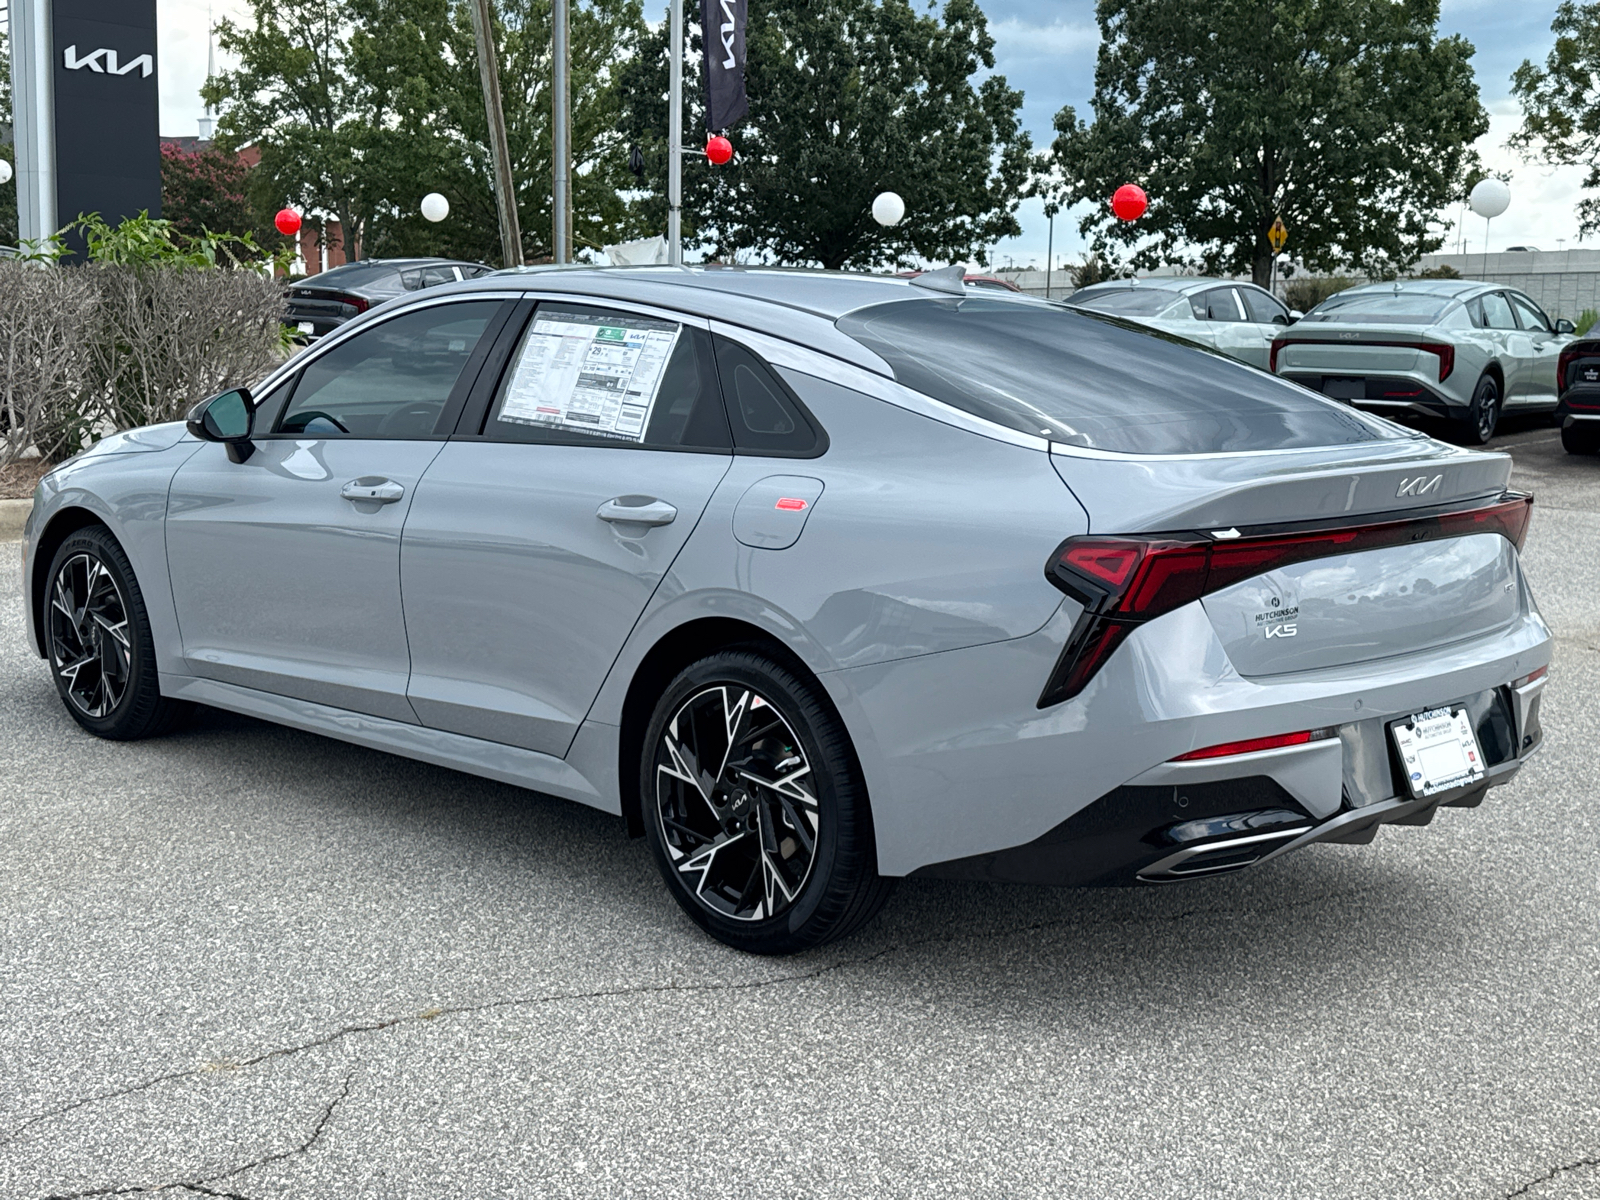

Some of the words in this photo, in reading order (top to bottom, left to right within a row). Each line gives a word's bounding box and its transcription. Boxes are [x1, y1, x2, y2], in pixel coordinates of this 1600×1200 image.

[63, 44, 153, 78] KIA
[591, 346, 602, 356] 29
[1395, 474, 1443, 498] KIA
[1255, 606, 1298, 621] HUTCHINSON
[1265, 623, 1298, 639] K5
[1416, 706, 1452, 724] HUTCHINSON
[731, 793, 748, 811] KIA
